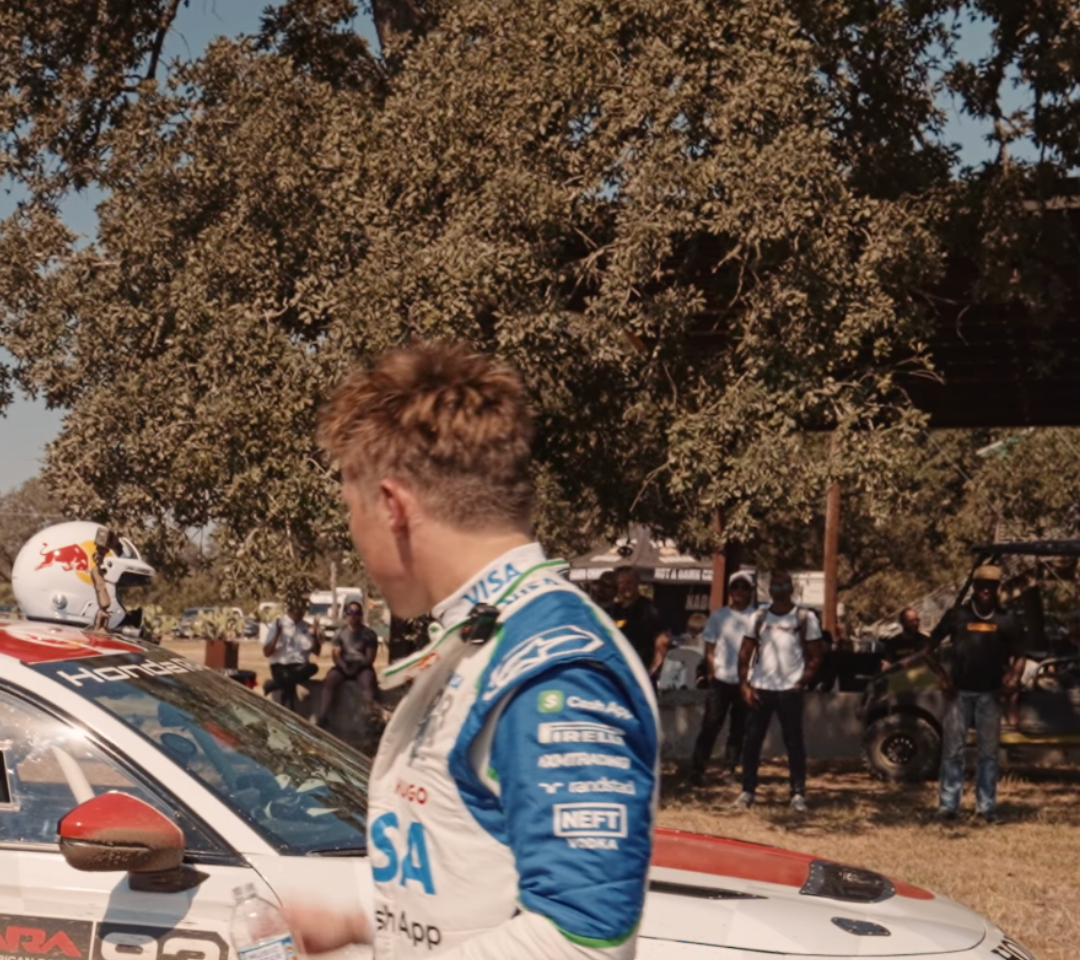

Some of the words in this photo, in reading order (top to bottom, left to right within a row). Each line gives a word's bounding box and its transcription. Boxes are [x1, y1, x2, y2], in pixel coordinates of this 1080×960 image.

[461, 563, 522, 605] VISA
[562, 810, 620, 829] NEFT
[371, 812, 436, 895] SA
[566, 838, 618, 850] VODKA
